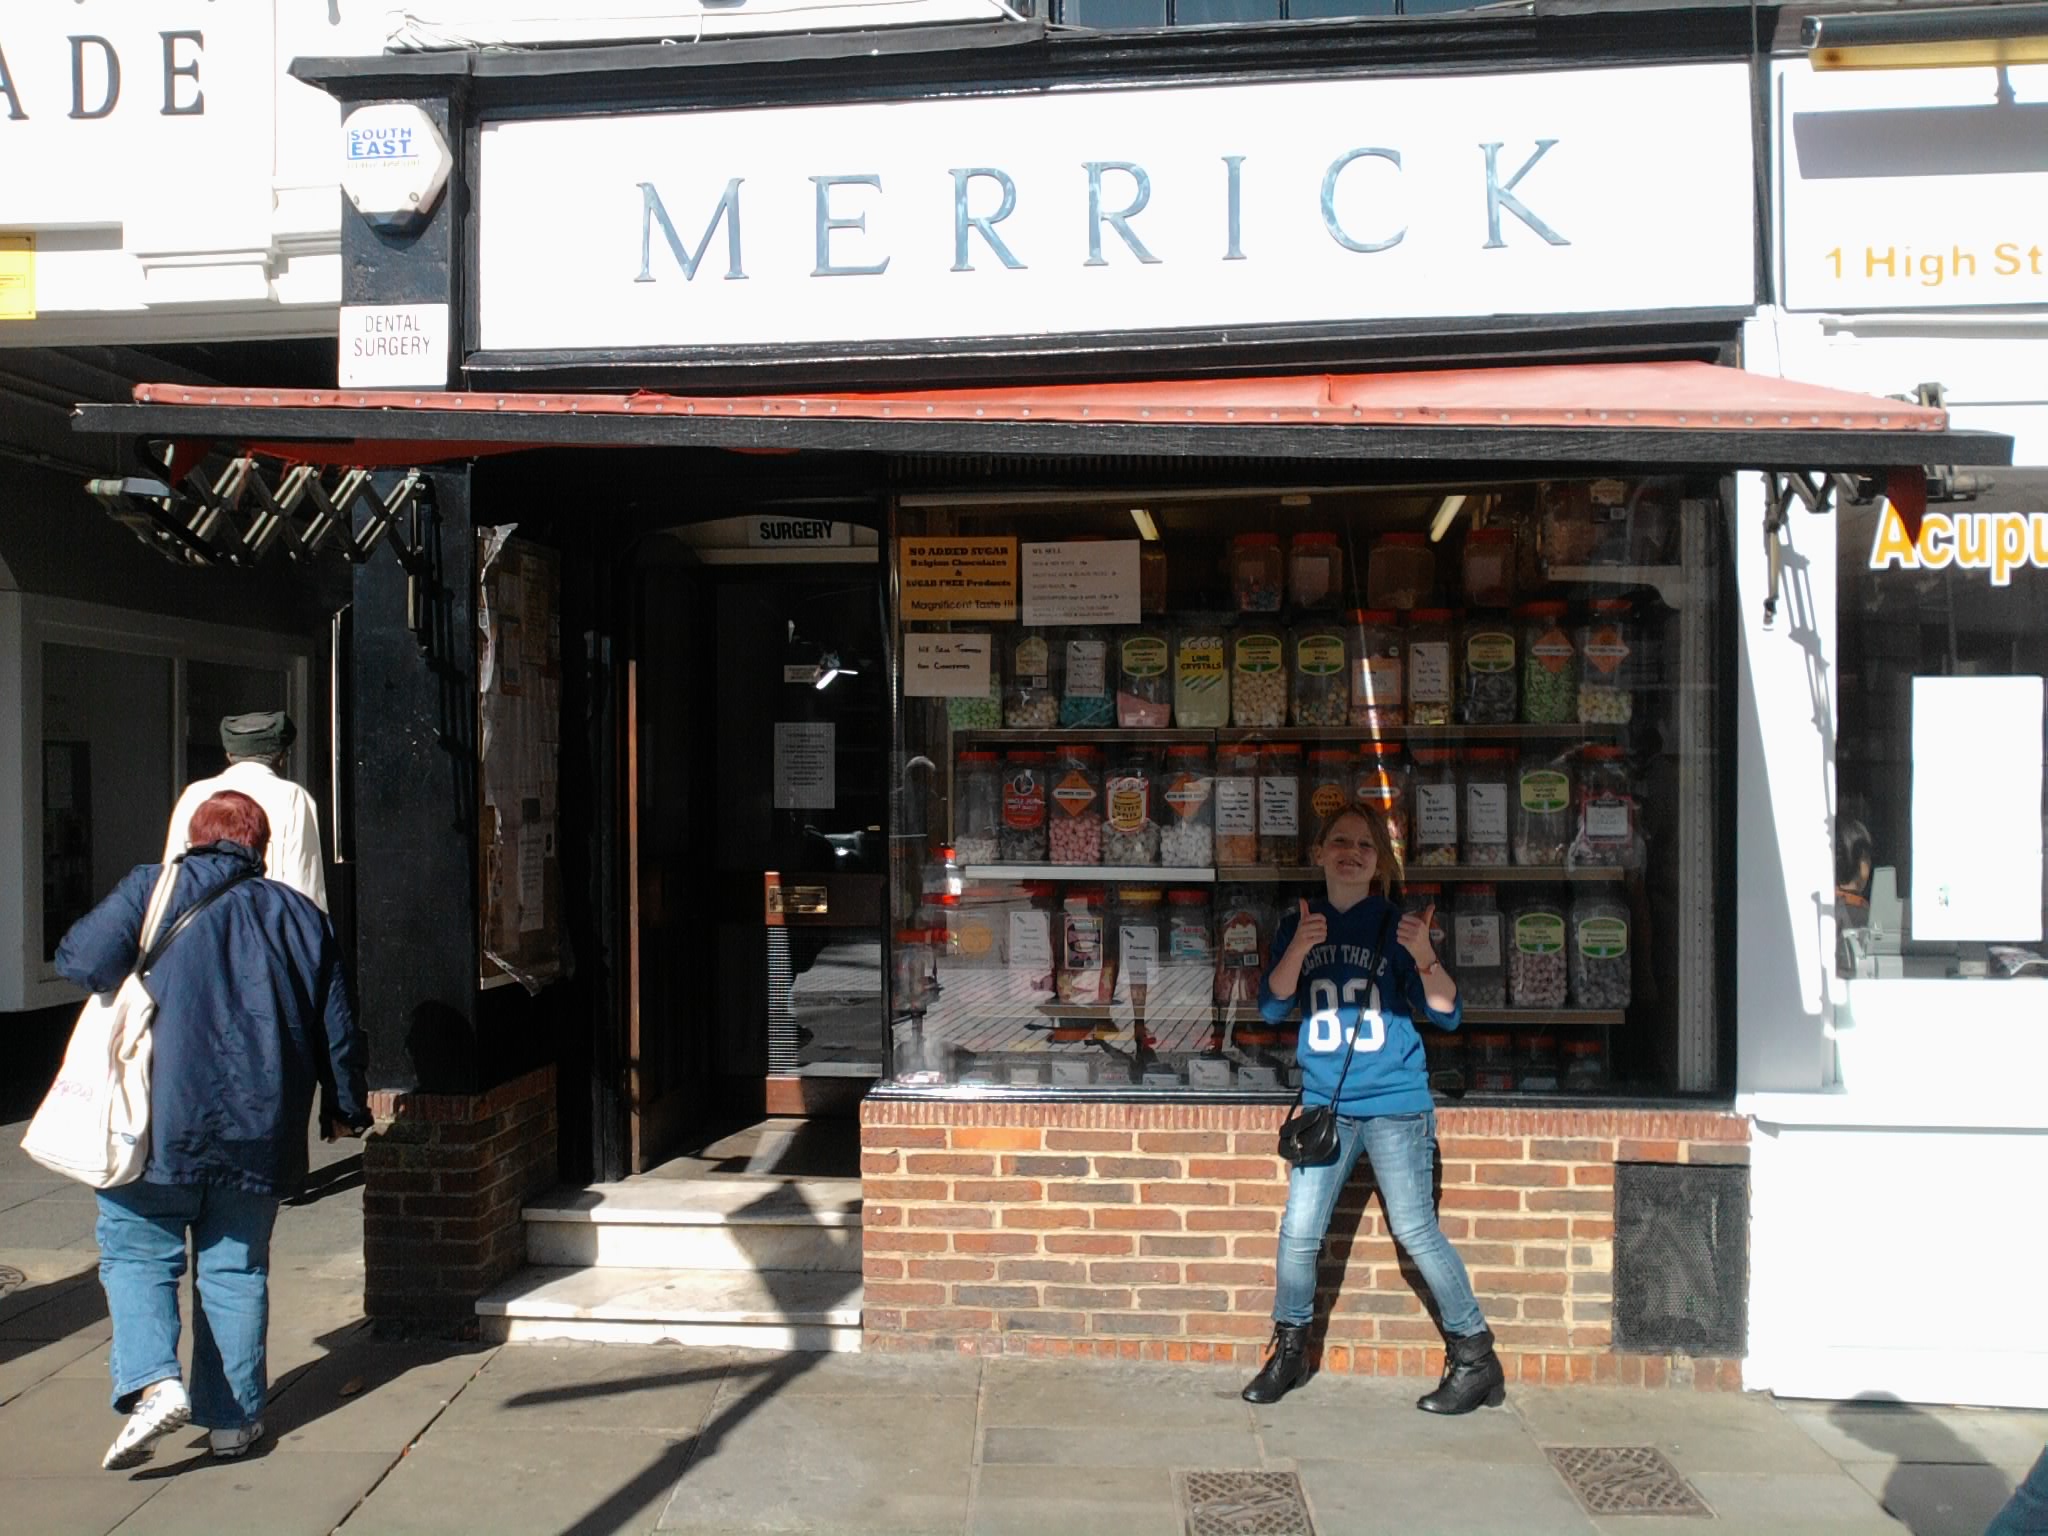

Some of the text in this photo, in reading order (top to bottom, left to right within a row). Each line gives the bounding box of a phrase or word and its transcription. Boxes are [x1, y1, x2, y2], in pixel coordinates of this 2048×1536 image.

[351, 128, 412, 141] SOUTH
[352, 139, 411, 156] EAST
[633, 139, 1571, 282] MERRICK
[1825, 242, 2044, 287] 1 High St
[365, 314, 420, 333] DENTAL
[354, 336, 430, 357] SURGERY
[760, 521, 833, 540] SURGERY
[909, 546, 1008, 556] NO ADDED SUGAR
[911, 559, 949, 568] Belgian
[939, 579, 965, 587] FREE
[967, 579, 1011, 587] Products
[911, 600, 972, 611] Magnificent
[975, 600, 1001, 609] Taste
[1180, 662, 1222, 670] CRYSTALS
[1308, 978, 1386, 1053] 83
